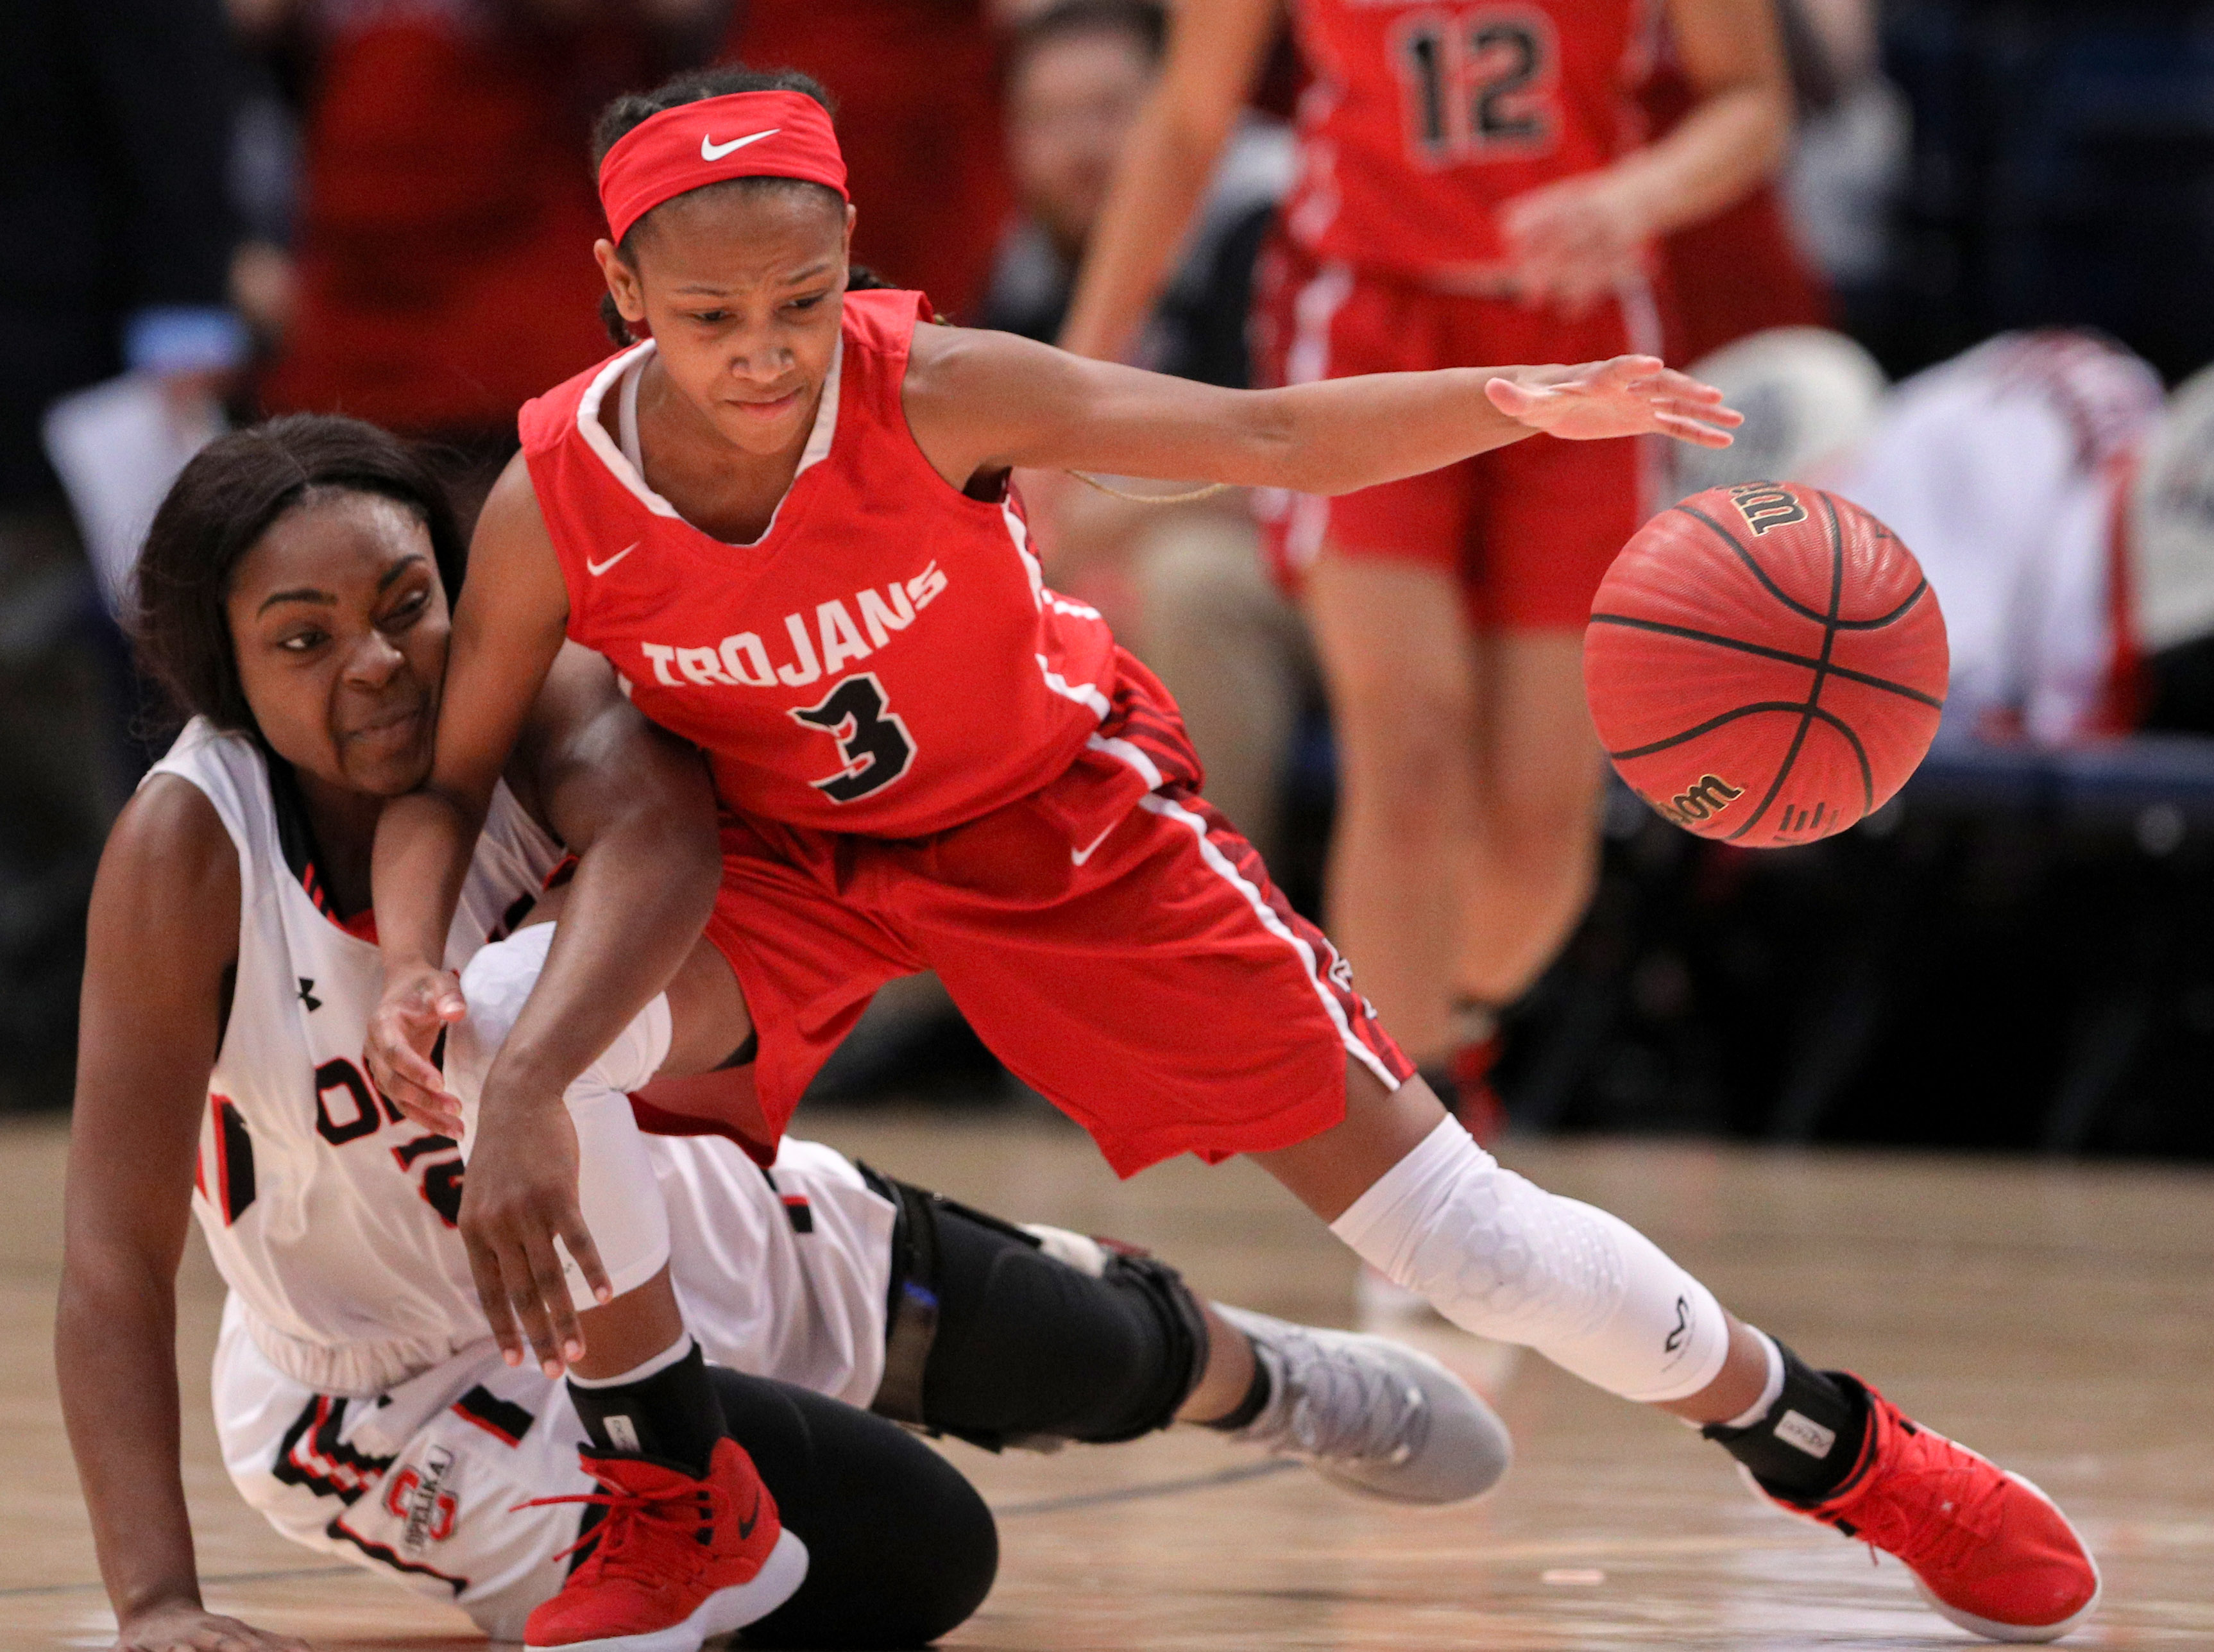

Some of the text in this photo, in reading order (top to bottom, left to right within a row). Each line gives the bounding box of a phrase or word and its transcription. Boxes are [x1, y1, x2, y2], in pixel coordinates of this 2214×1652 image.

[1393, 12, 1555, 162] 12
[642, 559, 949, 688] TROJANS
[787, 672, 918, 806] 3
